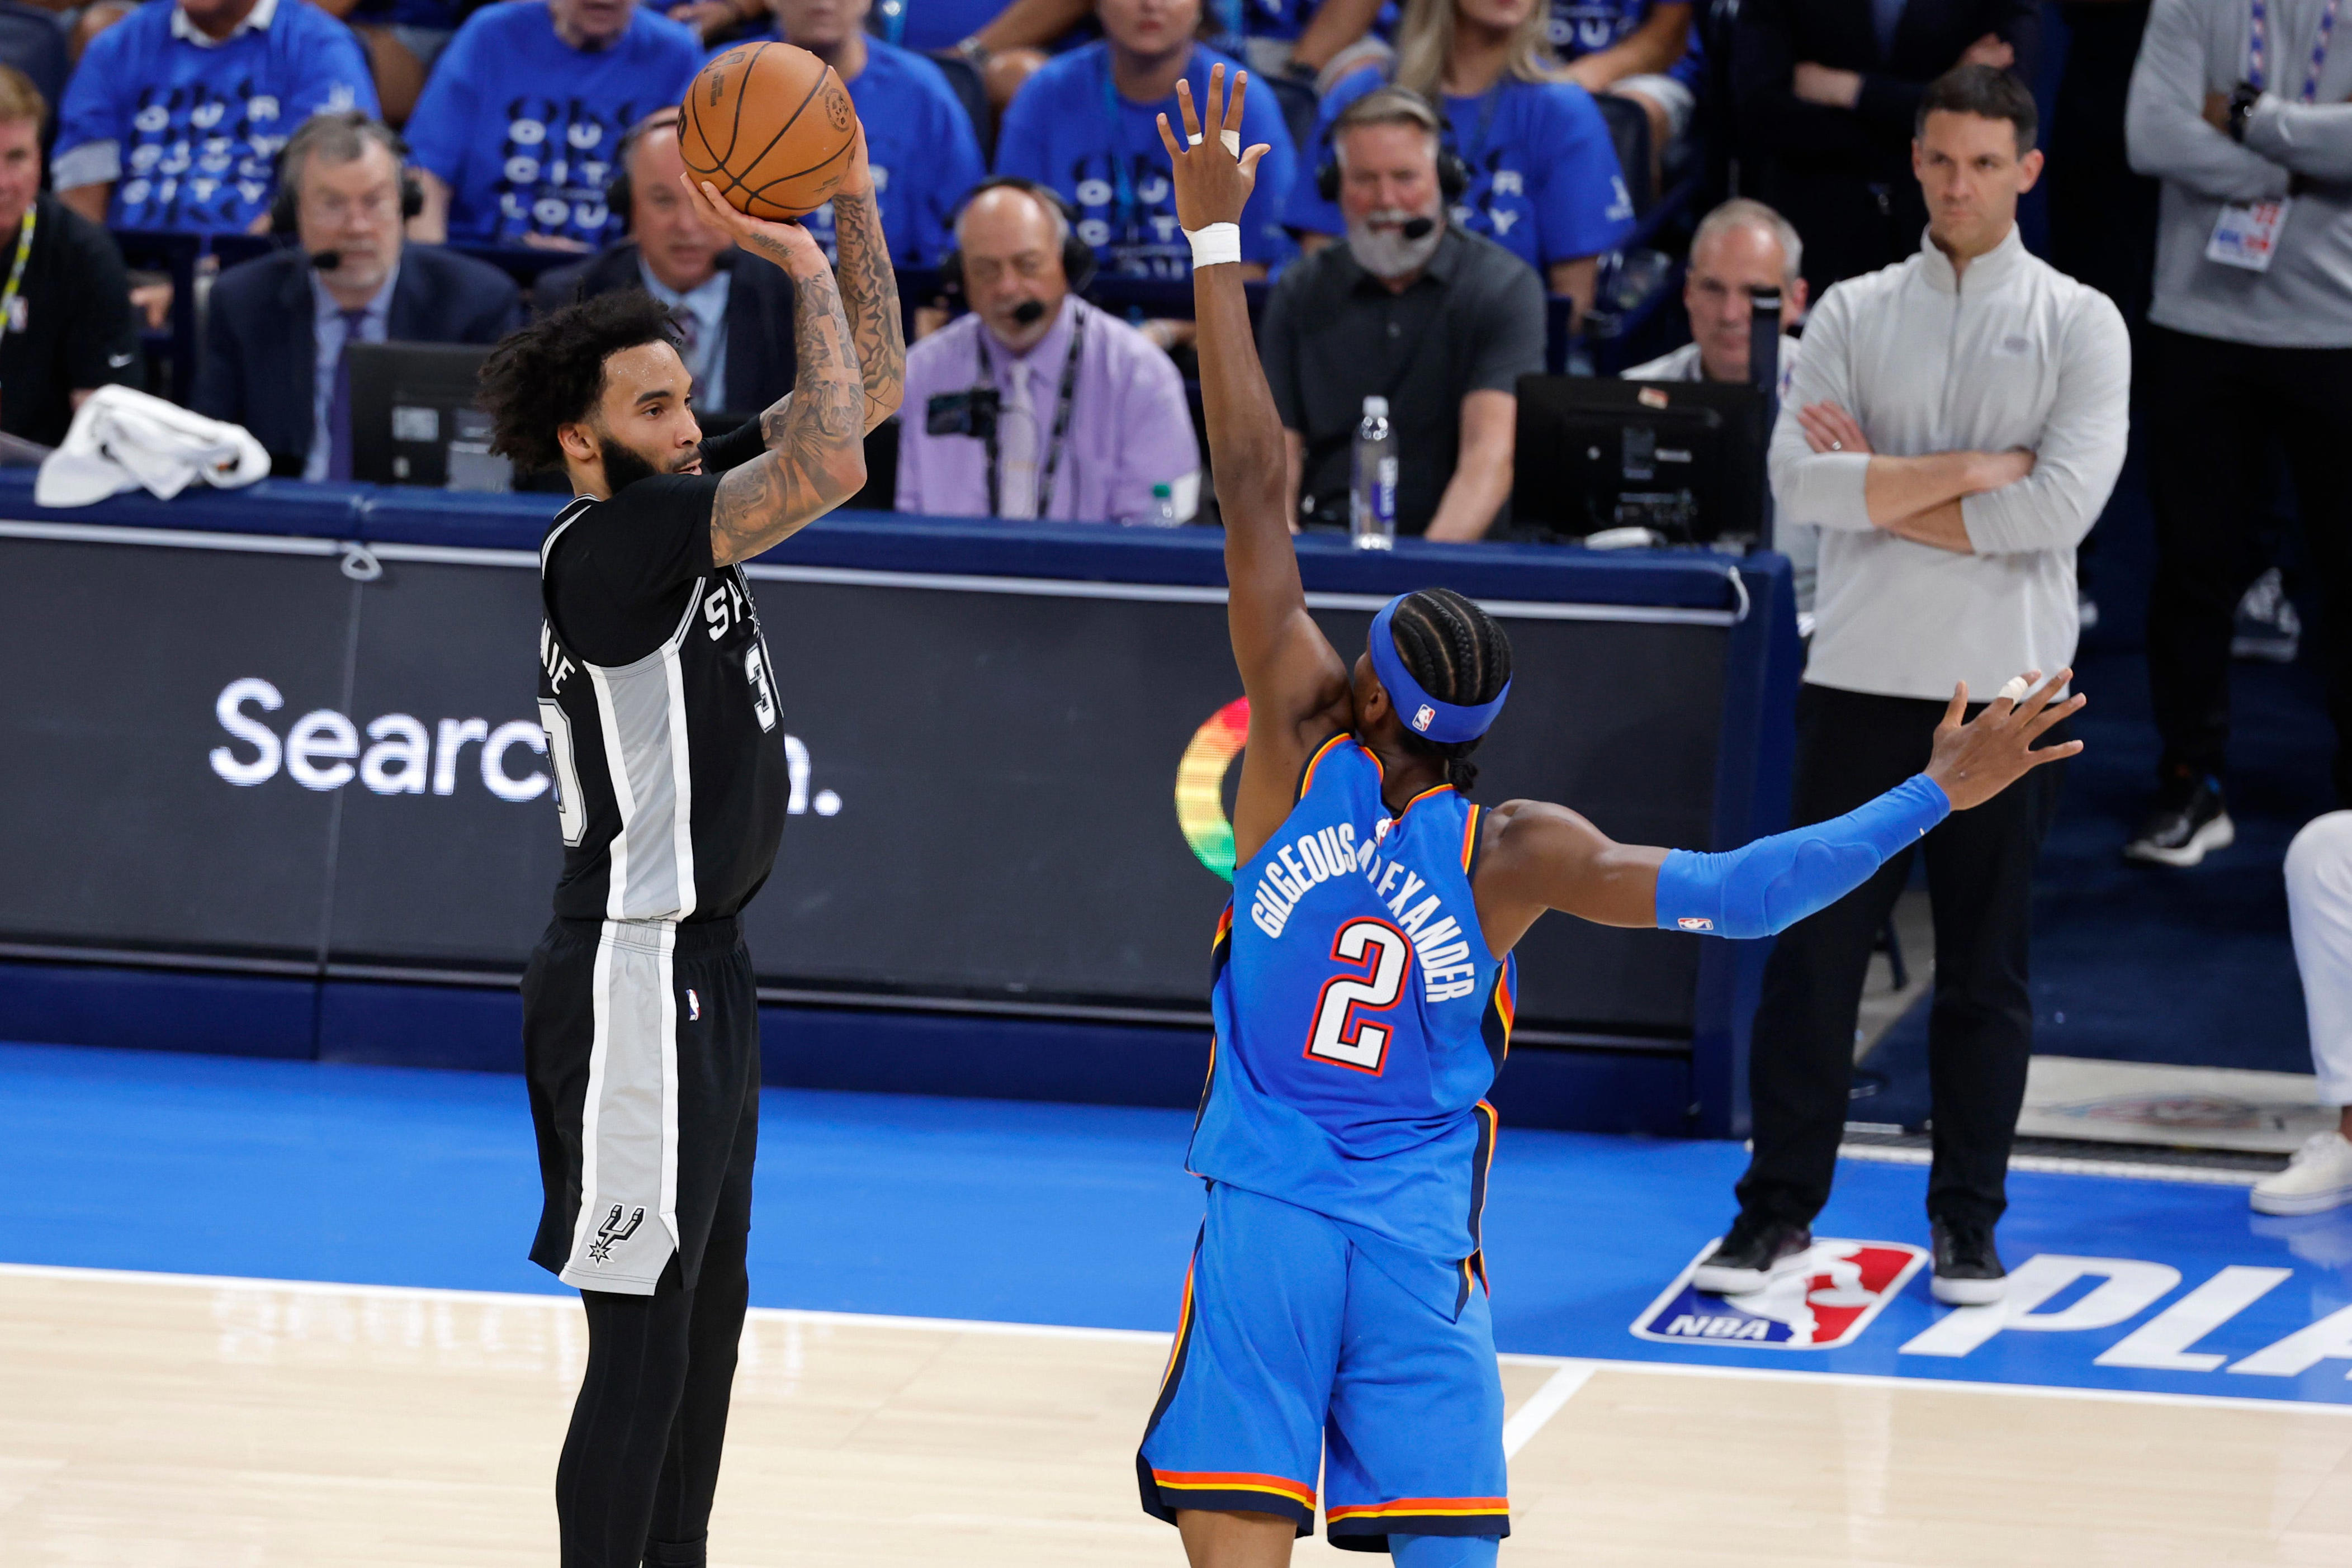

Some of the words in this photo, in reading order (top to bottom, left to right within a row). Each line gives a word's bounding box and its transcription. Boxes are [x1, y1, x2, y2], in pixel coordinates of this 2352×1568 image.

[209, 676, 555, 803] Searc
[1302, 916, 1413, 1077] 2
[1665, 1314, 1771, 1340] NBA
